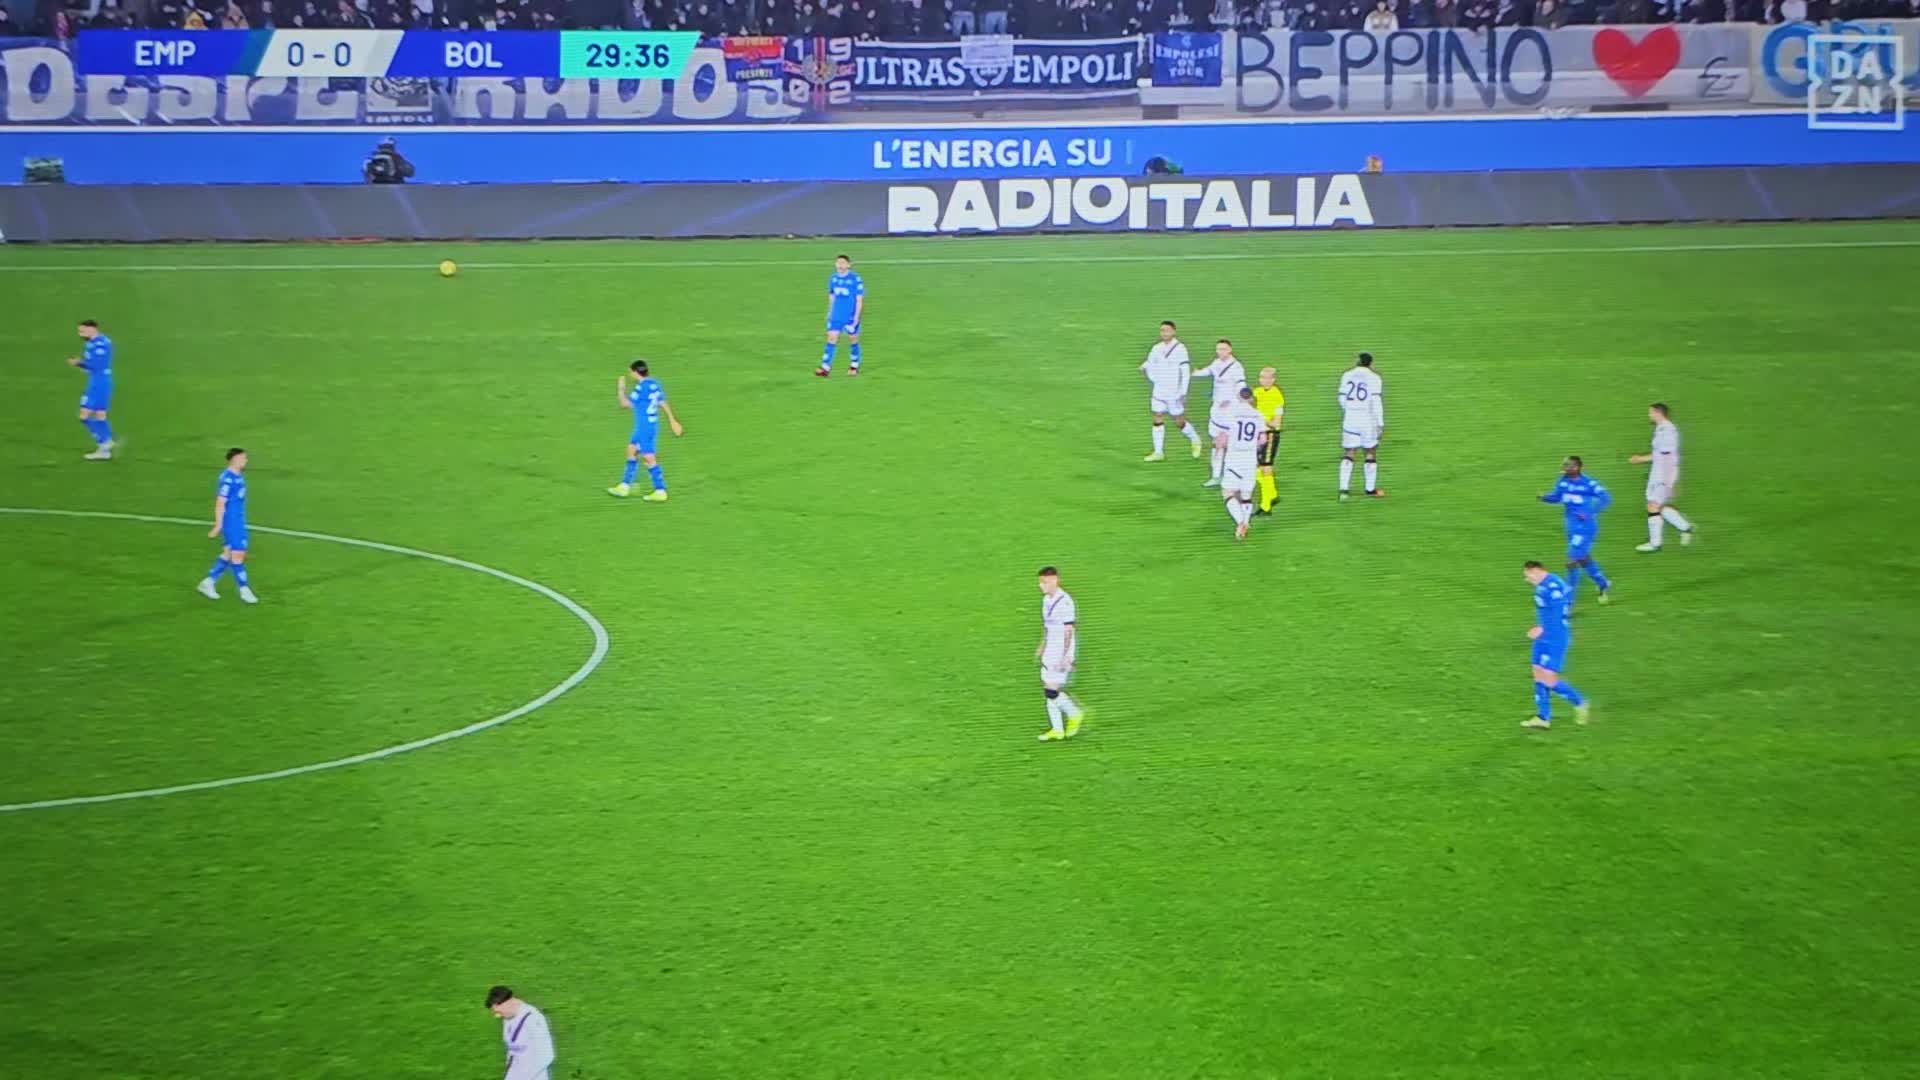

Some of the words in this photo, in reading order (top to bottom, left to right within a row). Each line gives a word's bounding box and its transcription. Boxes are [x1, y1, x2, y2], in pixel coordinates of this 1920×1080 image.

[1012, 51, 1133, 84] EMPOLI
[1234, 27, 1553, 114] BEPPINO
[873, 139, 1057, 169] L'ENERGIA
[1066, 138, 1112, 167] SU
[1346, 381, 1369, 401] 26
[1237, 420, 1256, 442] 19
